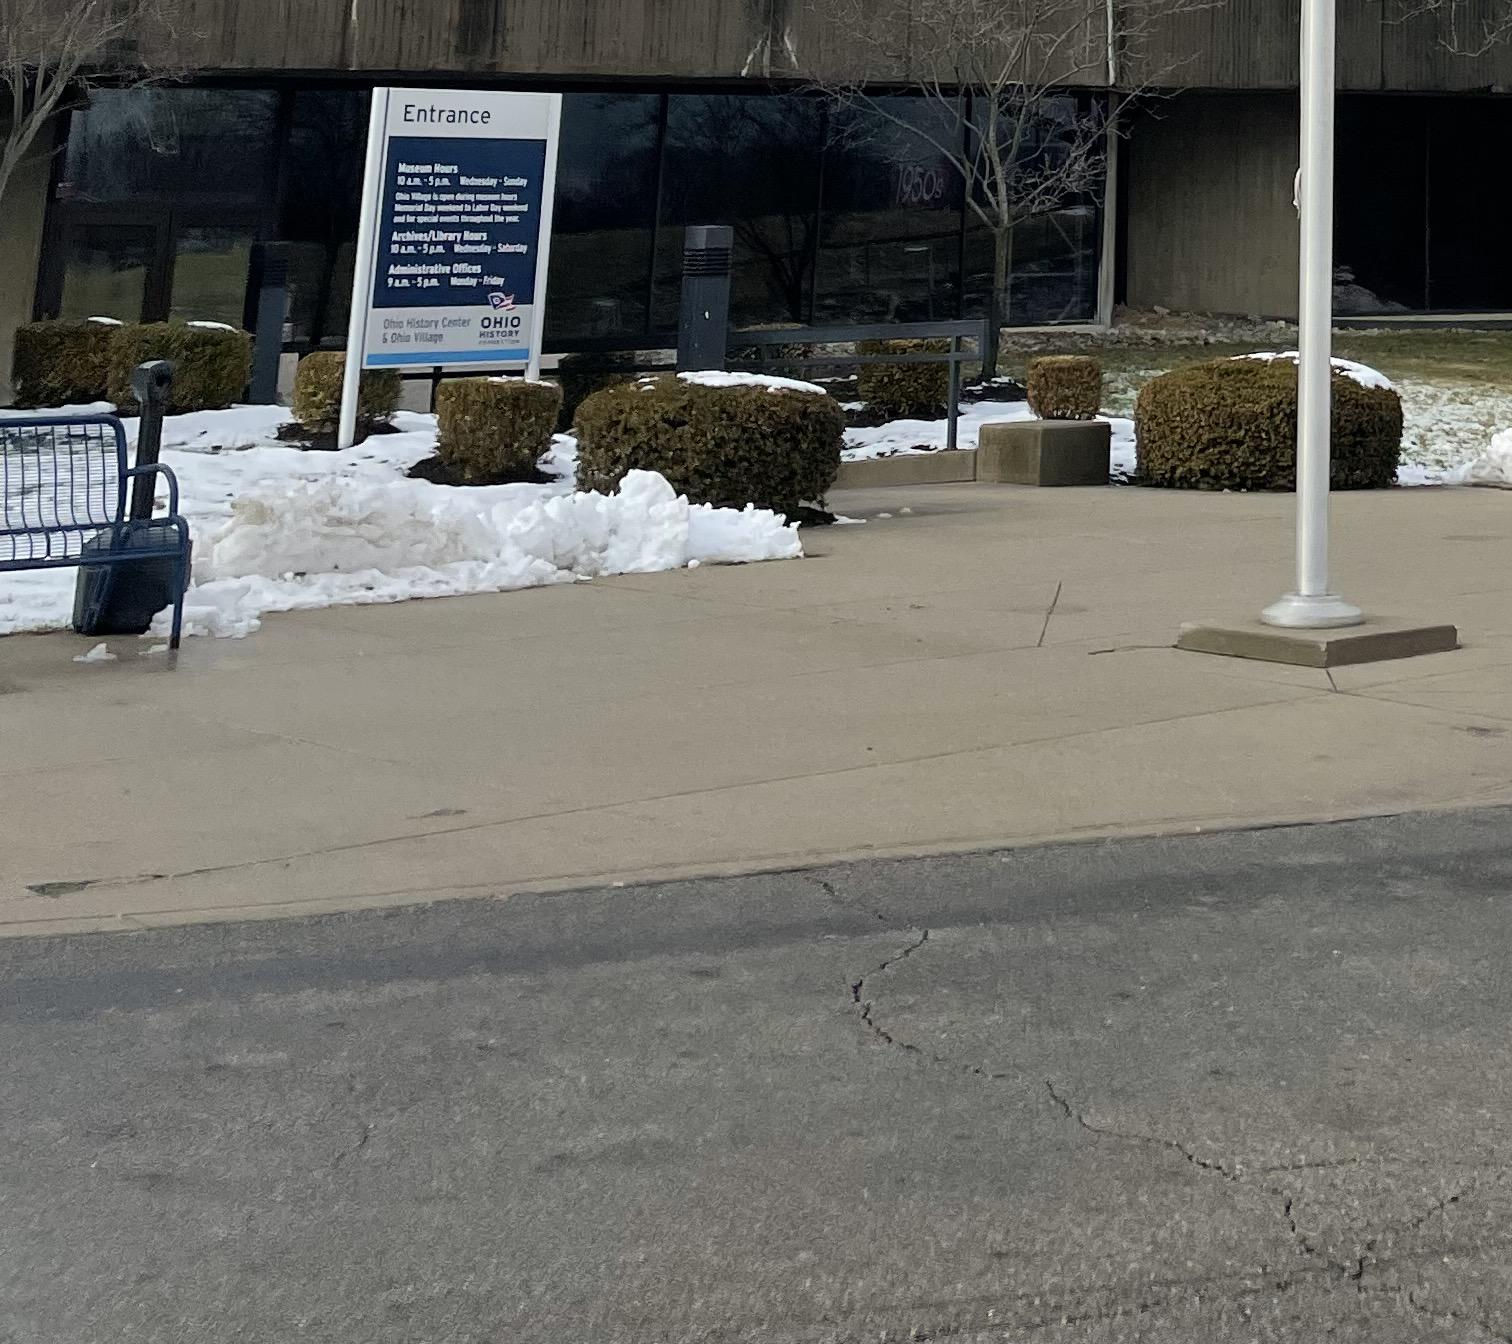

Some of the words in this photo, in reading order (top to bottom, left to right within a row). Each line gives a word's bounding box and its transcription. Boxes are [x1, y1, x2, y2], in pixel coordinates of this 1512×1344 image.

[403, 104, 491, 124] Entrance
[397, 162, 433, 174] Museum
[433, 163, 459, 174] Hours
[397, 175, 406, 186] 10
[428, 175, 434, 186] 5
[459, 175, 498, 188] Wednesday
[503, 175, 528, 188] Sunday
[391, 230, 462, 243] Archives/Library
[463, 230, 488, 241] Hours
[390, 243, 400, 254] 10
[422, 243, 429, 253] 5
[453, 243, 492, 255] Wednesday
[497, 243, 528, 254] Saturday
[388, 263, 451, 275] Administrative
[452, 263, 482, 274] Offices
[387, 277, 394, 287] 9
[416, 277, 423, 287] 5
[450, 276, 478, 287] Monday
[482, 275, 505, 287] Friday
[383, 318, 404, 329] Ohio
[406, 317, 440, 329] History
[441, 316, 471, 328] Center
[480, 316, 521, 329] OHIO
[382, 332, 388, 343] &
[390, 332, 411, 343] Ohio
[414, 332, 444, 344] Village
[479, 329, 520, 339] HISTORY
